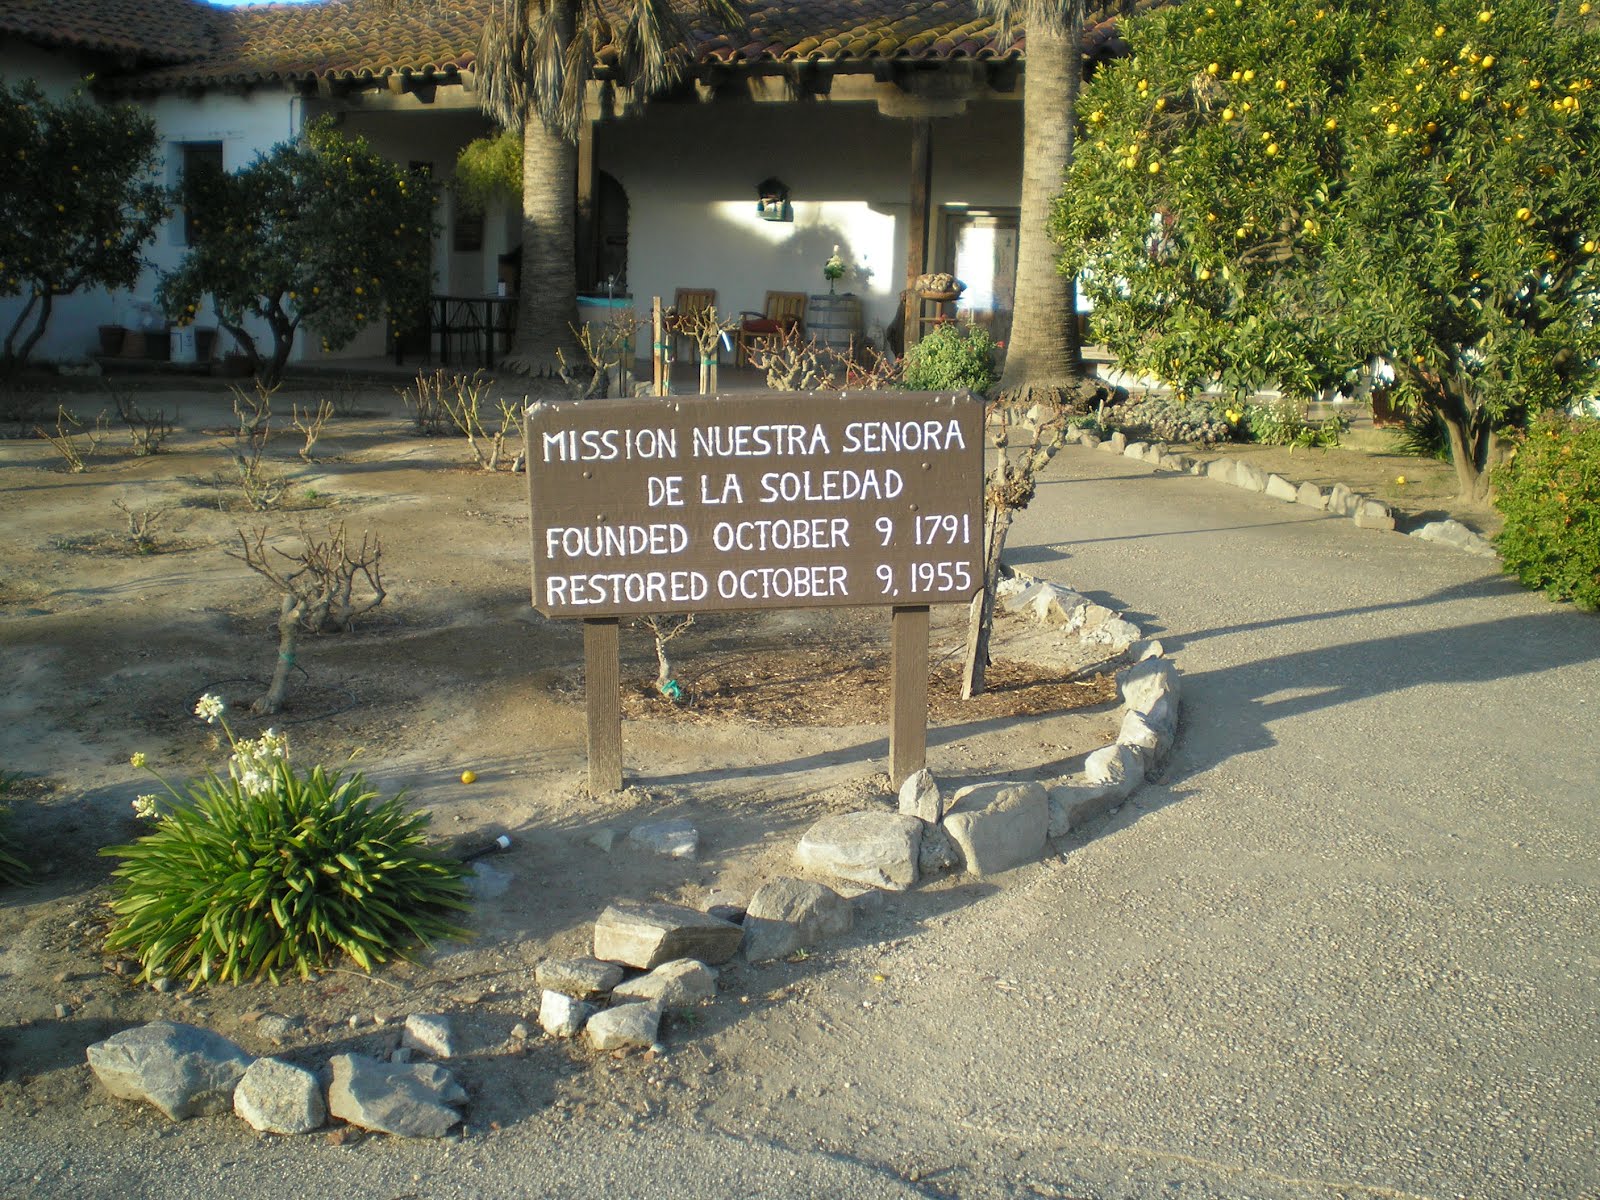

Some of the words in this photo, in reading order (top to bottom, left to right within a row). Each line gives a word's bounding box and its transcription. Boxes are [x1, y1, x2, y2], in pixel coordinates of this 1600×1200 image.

[541, 428, 677, 462] MISSION
[692, 423, 832, 457] NUESTRA
[842, 419, 966, 453] SENORA
[647, 475, 685, 508] DE
[700, 473, 744, 505] LA
[759, 468, 904, 503] SOLEDAD
[546, 523, 689, 559] FOUNDED
[712, 517, 850, 552] OCTOBER
[914, 513, 971, 546] 1791
[546, 571, 709, 607] RESTORED
[717, 565, 849, 600] OCTOBER
[875, 564, 900, 596] 9,
[909, 560, 972, 593] 1955
